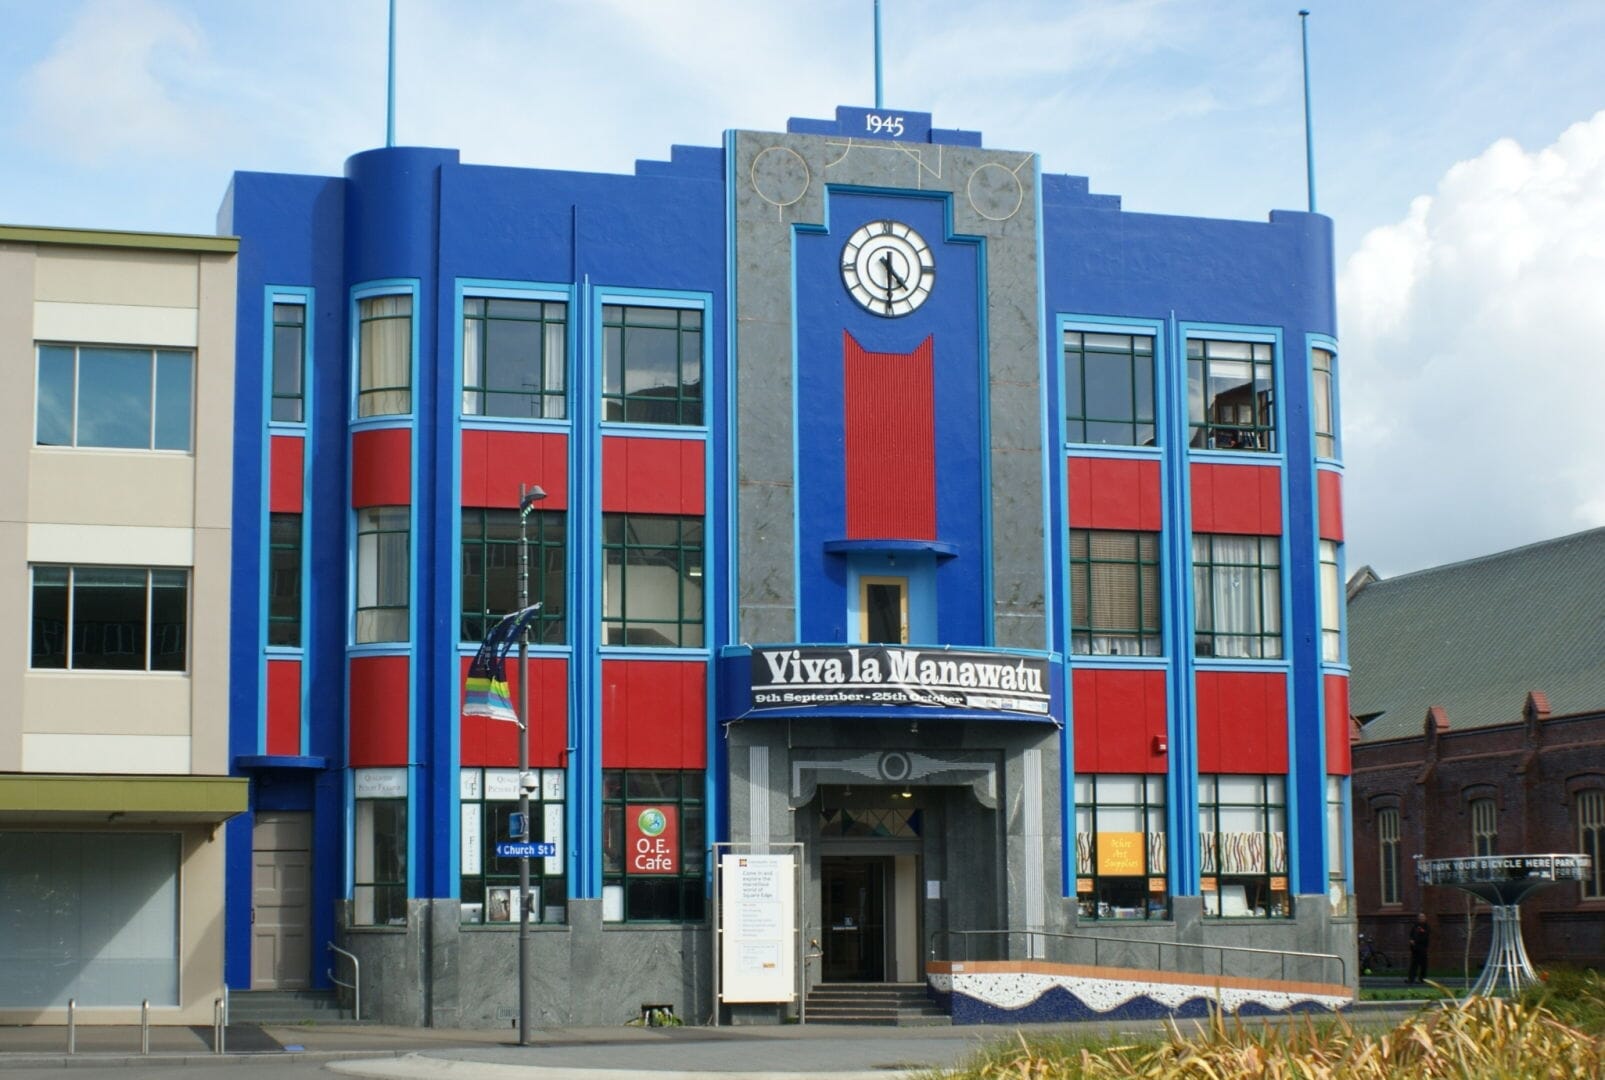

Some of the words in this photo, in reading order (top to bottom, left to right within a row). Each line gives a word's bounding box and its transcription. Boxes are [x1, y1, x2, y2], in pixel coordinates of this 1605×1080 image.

[866, 113, 904, 137] 1945
[762, 649, 845, 684] Viva
[848, 648, 882, 683] la
[886, 649, 1043, 693] Manawatu
[755, 693, 781, 703] 9th
[783, 692, 864, 704] September
[872, 692, 907, 702] 25th
[908, 693, 963, 705] October
[503, 845, 535, 855] Church
[537, 845, 549, 855] St
[636, 838, 670, 854] O.E.
[635, 854, 672, 870] Cafe
[1453, 861, 1477, 870] YOUR
[1525, 859, 1551, 867] HERE
[1555, 858, 1575, 867] PARK
